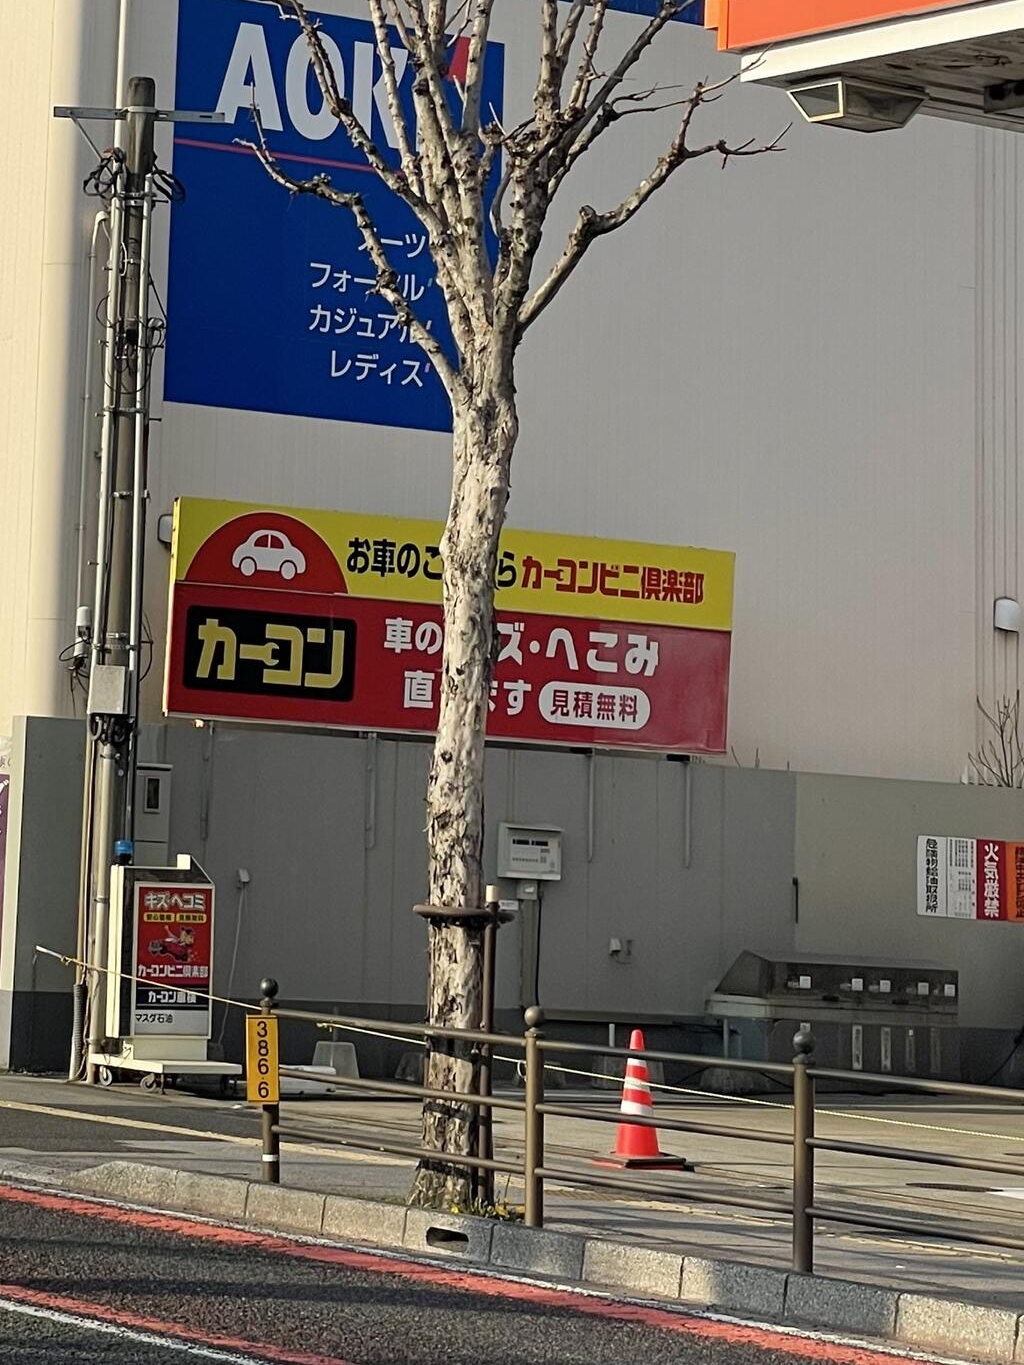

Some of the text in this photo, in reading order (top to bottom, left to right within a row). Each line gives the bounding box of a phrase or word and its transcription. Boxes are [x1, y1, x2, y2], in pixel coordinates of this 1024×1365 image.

[215, 22, 422, 152] AOK
[358, 228, 426, 258] ーツ
[310, 262, 425, 301] フォール
[331, 350, 424, 387] レディス
[347, 537, 517, 589] お車のこら
[196, 618, 344, 689] カーコン
[384, 617, 659, 677] 車のズ・へこみ
[403, 670, 638, 723] 直す 見積無料
[984, 842, 999, 918] 火気厳禁
[256, 1020, 270, 1099] 386.6
